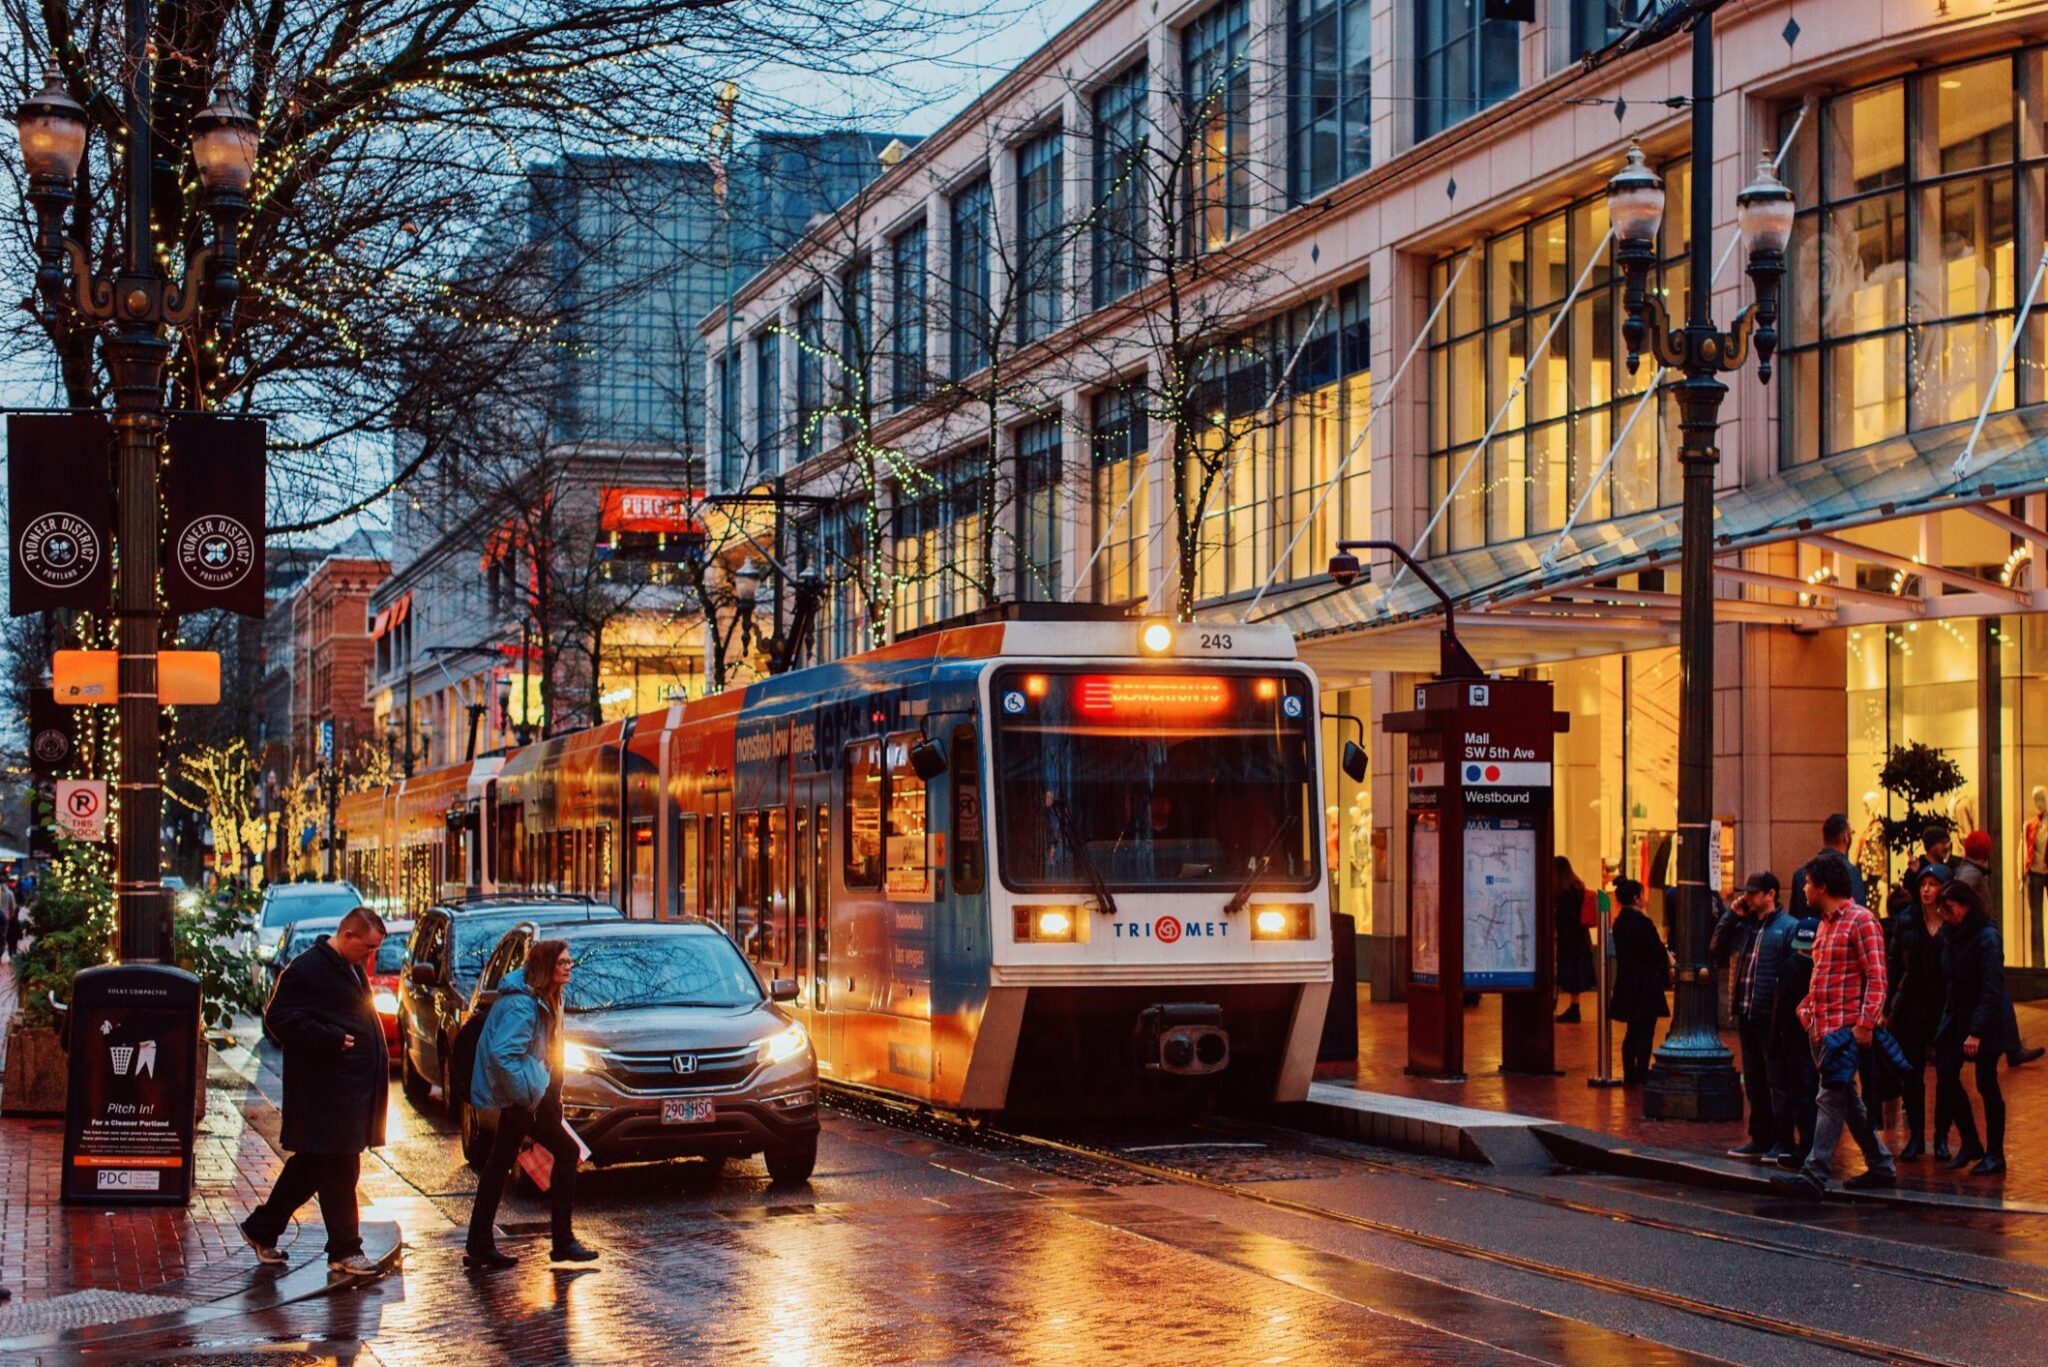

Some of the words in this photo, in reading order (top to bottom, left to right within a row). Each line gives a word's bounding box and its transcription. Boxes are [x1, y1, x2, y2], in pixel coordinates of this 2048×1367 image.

[27, 518, 57, 562] PIONEER
[61, 519, 93, 562] DISTRICT
[183, 522, 213, 563] PIONEER
[218, 523, 248, 565] DISTRICT
[42, 568, 78, 580] PORTLAND
[199, 570, 233, 582] PORTLAND
[1200, 633, 1232, 650] 243
[737, 730, 771, 762] nonstop
[772, 723, 788, 756] low
[791, 719, 815, 753] fares
[1465, 732, 1489, 745] Mall
[1465, 747, 1485, 759] SW
[1489, 746, 1510, 759] 5th
[1513, 747, 1535, 759] Ave
[1465, 791, 1530, 804] Westbound
[72, 819, 93, 828] THIS
[1467, 821, 1492, 831] MAX
[129, 988, 168, 996] COMPACTOR
[107, 1103, 136, 1115] Pitch
[139, 1103, 155, 1115] In!
[665, 1102, 684, 1117] 290
[692, 1100, 712, 1115] HSC
[91, 1119, 103, 1127] For
[110, 1119, 138, 1127] Cleaner
[139, 1120, 169, 1128] Portland
[98, 1172, 128, 1185] PDC
